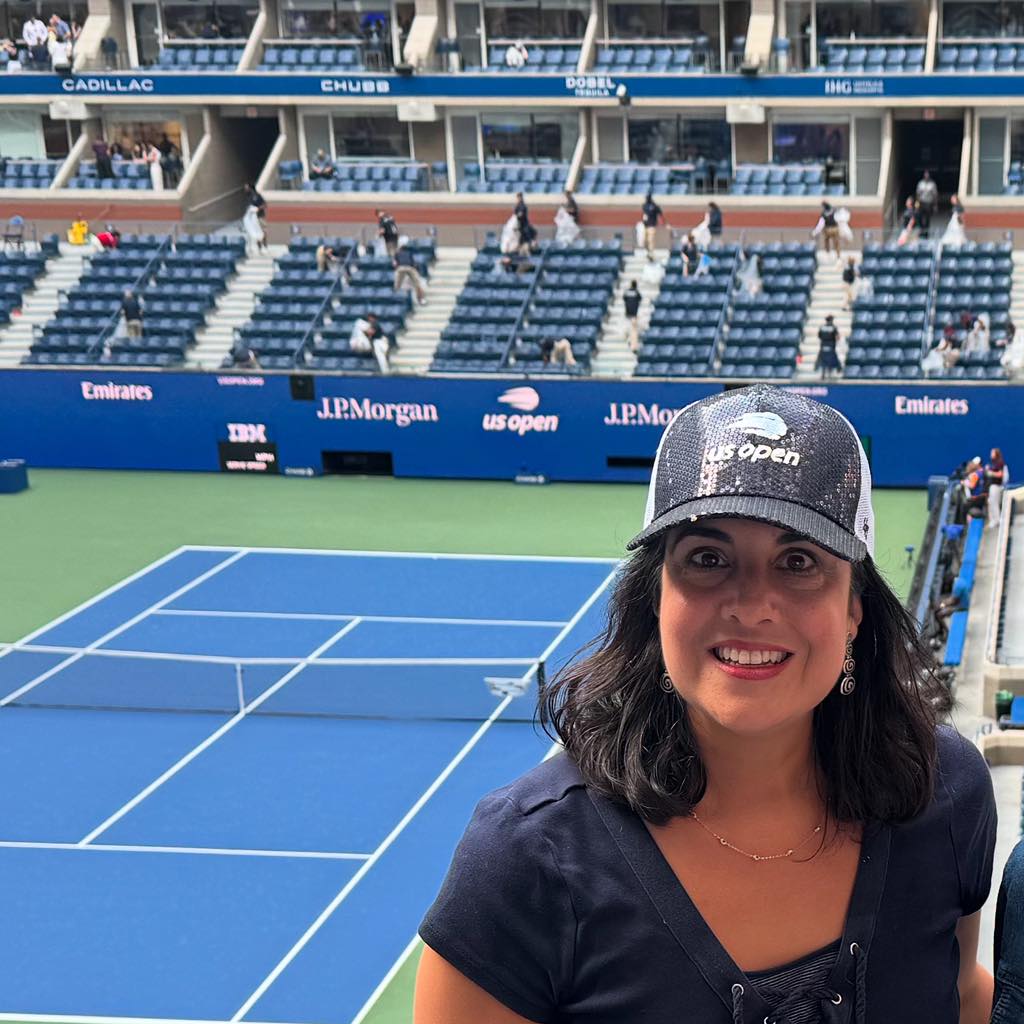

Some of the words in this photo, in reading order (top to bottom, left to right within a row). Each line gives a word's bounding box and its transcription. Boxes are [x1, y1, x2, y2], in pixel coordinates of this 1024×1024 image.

[62, 79, 154, 92] CADILLAC
[320, 80, 390, 93] CHUBB
[81, 381, 153, 400] Emirates
[317, 397, 439, 427] J.P.Morgan
[603, 402, 681, 426] J.P.Mo
[895, 395, 969, 415] Emirates
[226, 423, 267, 443] IBM
[482, 414, 507, 431] us
[507, 414, 559, 436] open
[738, 443, 800, 467] open
